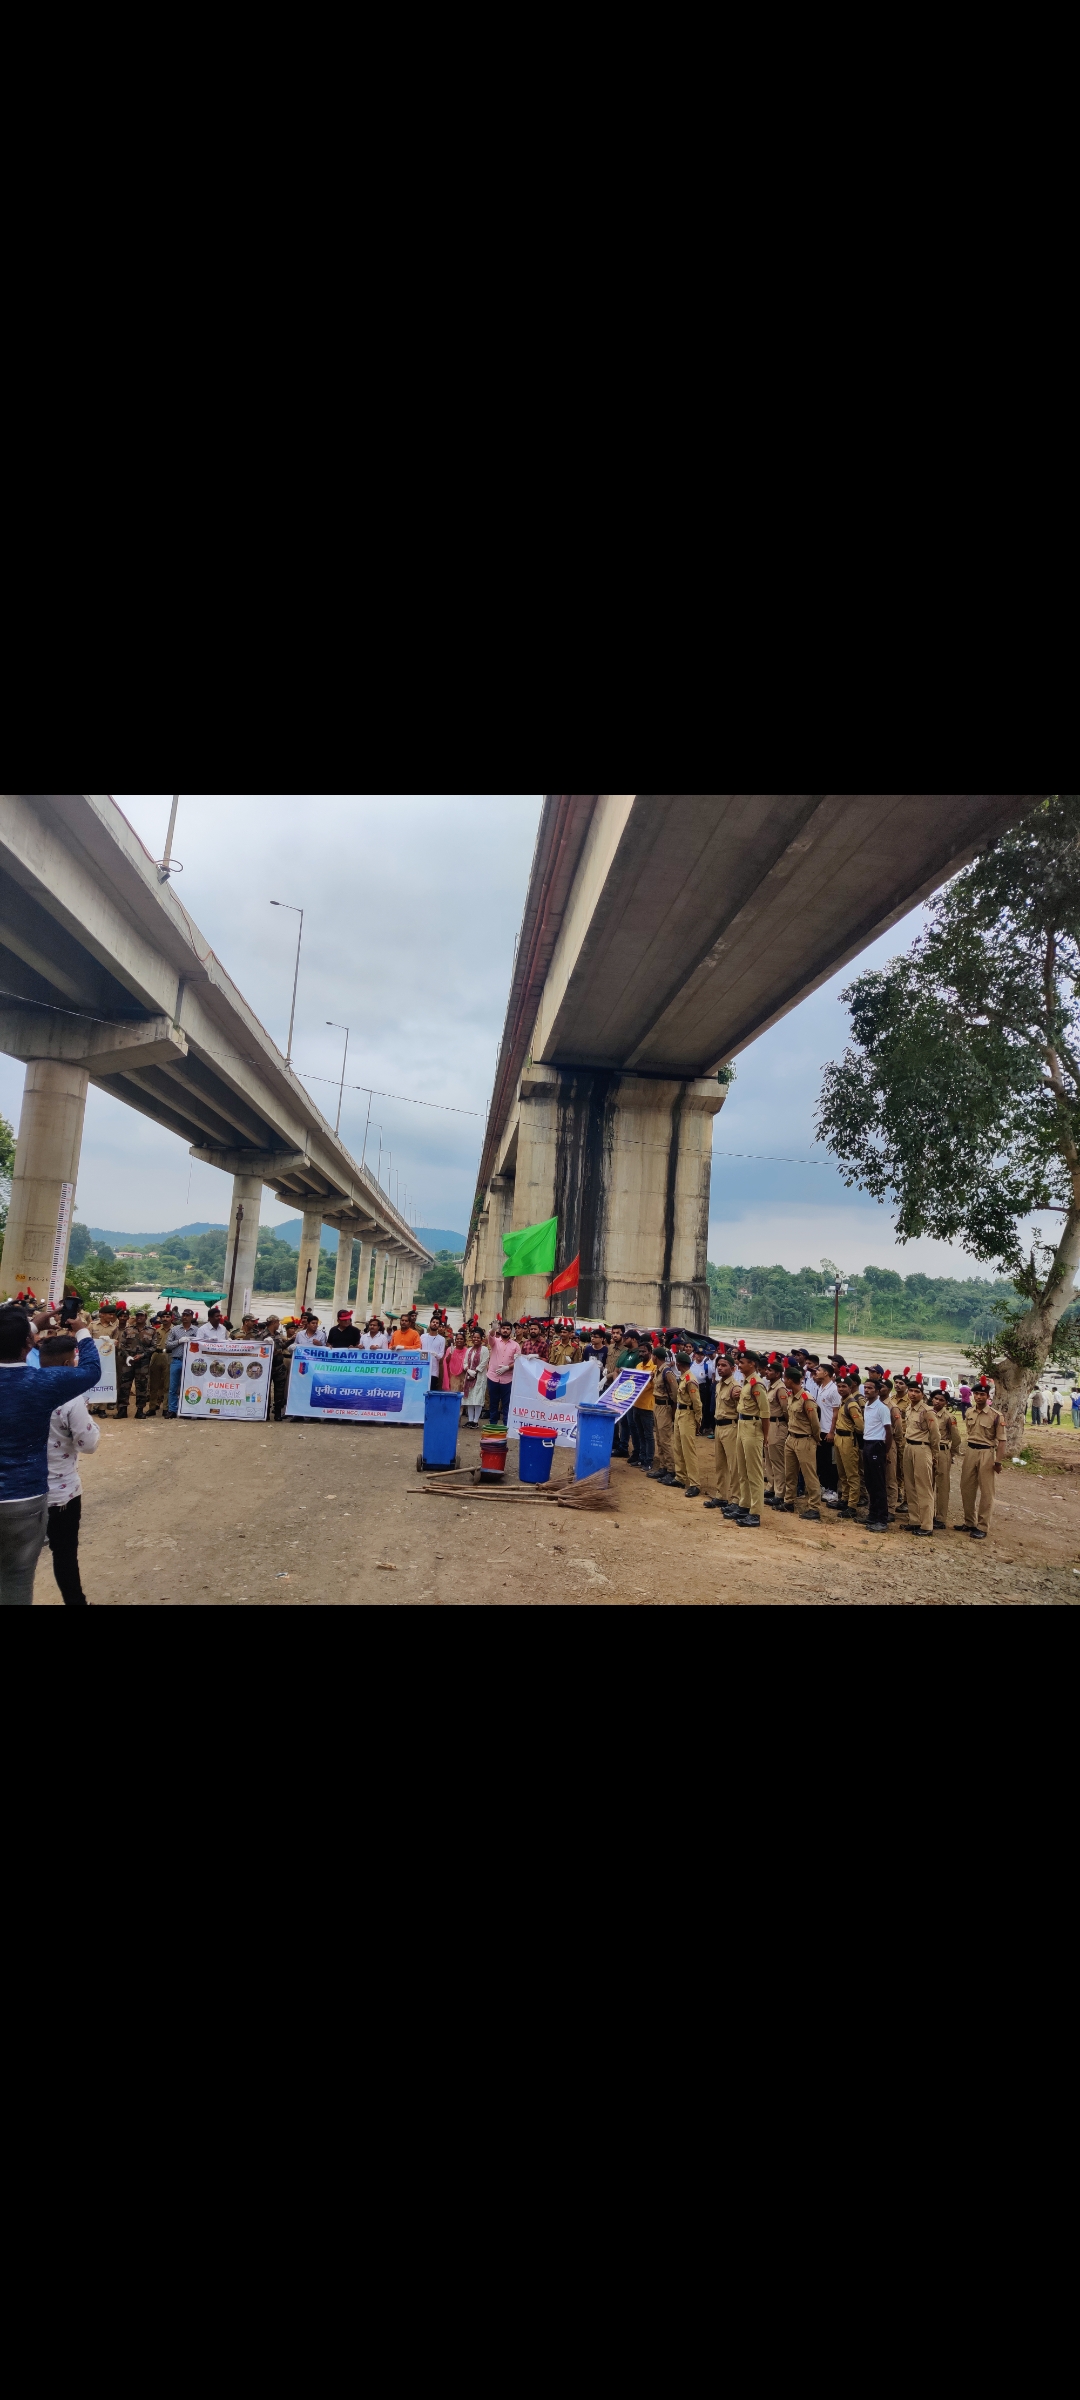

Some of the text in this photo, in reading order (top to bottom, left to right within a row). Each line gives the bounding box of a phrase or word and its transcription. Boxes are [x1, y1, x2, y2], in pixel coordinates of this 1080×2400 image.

[303, 1349, 329, 1358] SHRI
[332, 1351, 358, 1360] RAM
[361, 1352, 398, 1361] GROUP
[314, 1364, 407, 1375] NATIONAL CADET CORPS
[314, 1385, 401, 1399] पुनीत सागर अभियान
[205, 1398, 242, 1406] ABHIYAN
[513, 1407, 577, 1423] 4 MP CTR JABAL
